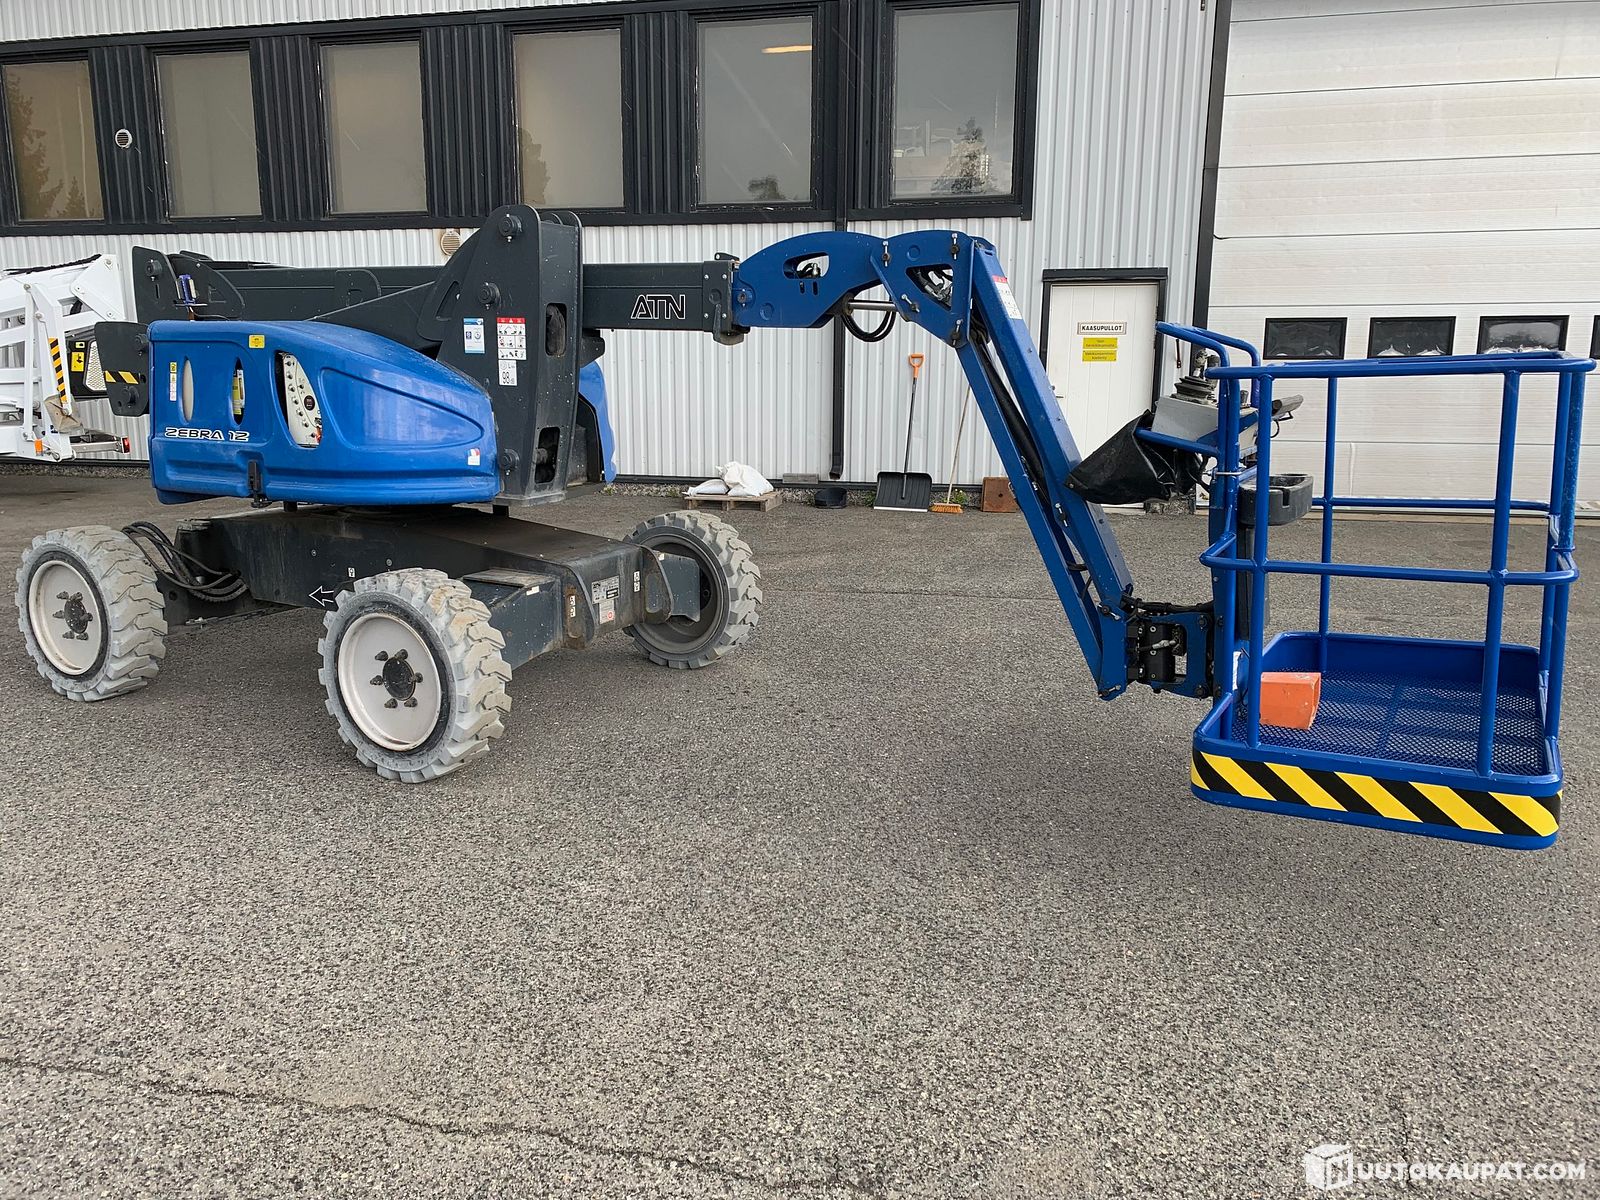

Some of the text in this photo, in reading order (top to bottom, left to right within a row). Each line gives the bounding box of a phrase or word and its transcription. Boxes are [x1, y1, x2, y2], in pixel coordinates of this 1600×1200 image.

[630, 294, 686, 319] ATN
[165, 427, 249, 441] ZEBRA 12
